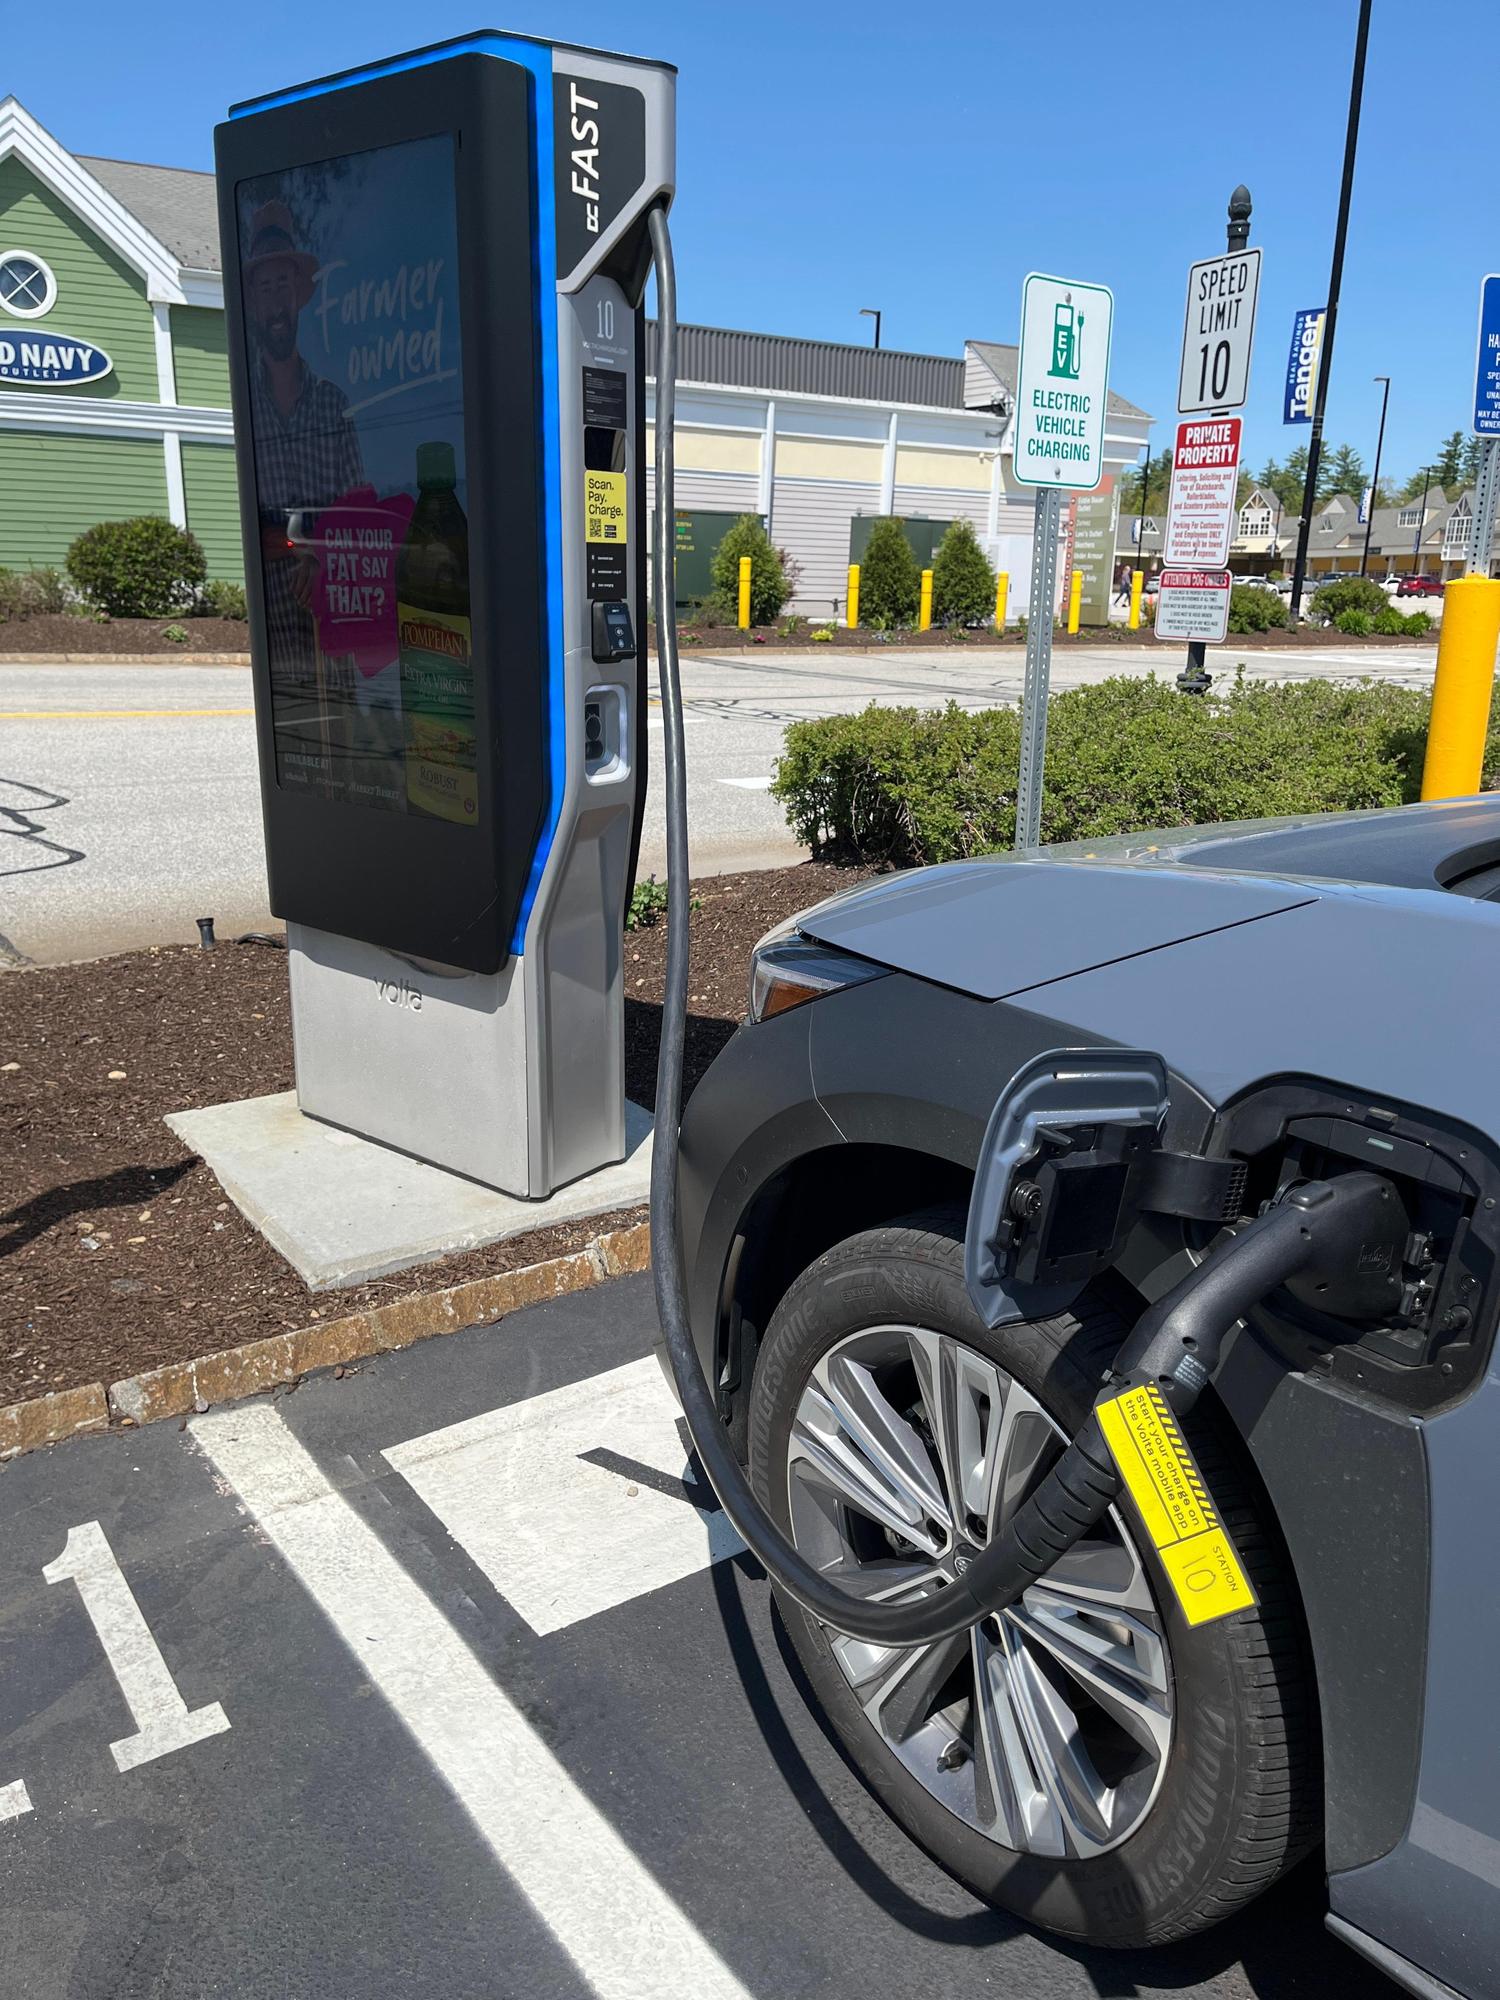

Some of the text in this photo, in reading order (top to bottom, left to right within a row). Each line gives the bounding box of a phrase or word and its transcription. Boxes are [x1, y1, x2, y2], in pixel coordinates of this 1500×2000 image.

[570, 82, 600, 200] FAST
[1199, 262, 1248, 302] SPEED
[312, 258, 445, 354] Farmer
[597, 300, 614, 340] 10
[1200, 298, 1242, 335] LIMIT
[348, 297, 444, 384] owned
[20, 343, 93, 372] NAVY
[1199, 340, 1231, 402] 10
[1290, 314, 1320, 419] Tanger
[1, 366, 60, 379] OUTLET
[1033, 389, 1091, 413] ELECTRIC
[1478, 410, 1490, 418] MAY
[1036, 414, 1086, 437] VEHICLE
[1185, 424, 1232, 445] PRIVATE
[1027, 437, 1090, 462] CHARGING
[1178, 444, 1235, 465] PROPERTY
[588, 478, 614, 490] Scan.
[588, 491, 607, 505] Pay.
[588, 504, 624, 519] Charge.
[325, 527, 393, 550] CAN YOUR
[326, 552, 389, 582] FAT SAY
[1162, 573, 1191, 586] ATTENTION
[325, 584, 385, 616] THAT?
[404, 624, 464, 657] POMPEIAN
[432, 672, 468, 695] VIRGIN
[419, 766, 457, 790] ROBUST
[1125, 1400, 1189, 1530] the volta mobile app
[1136, 1395, 1200, 1526] Start your charge on
[1211, 1546, 1238, 1592] STATION
[42, 1520, 232, 1773] 1
